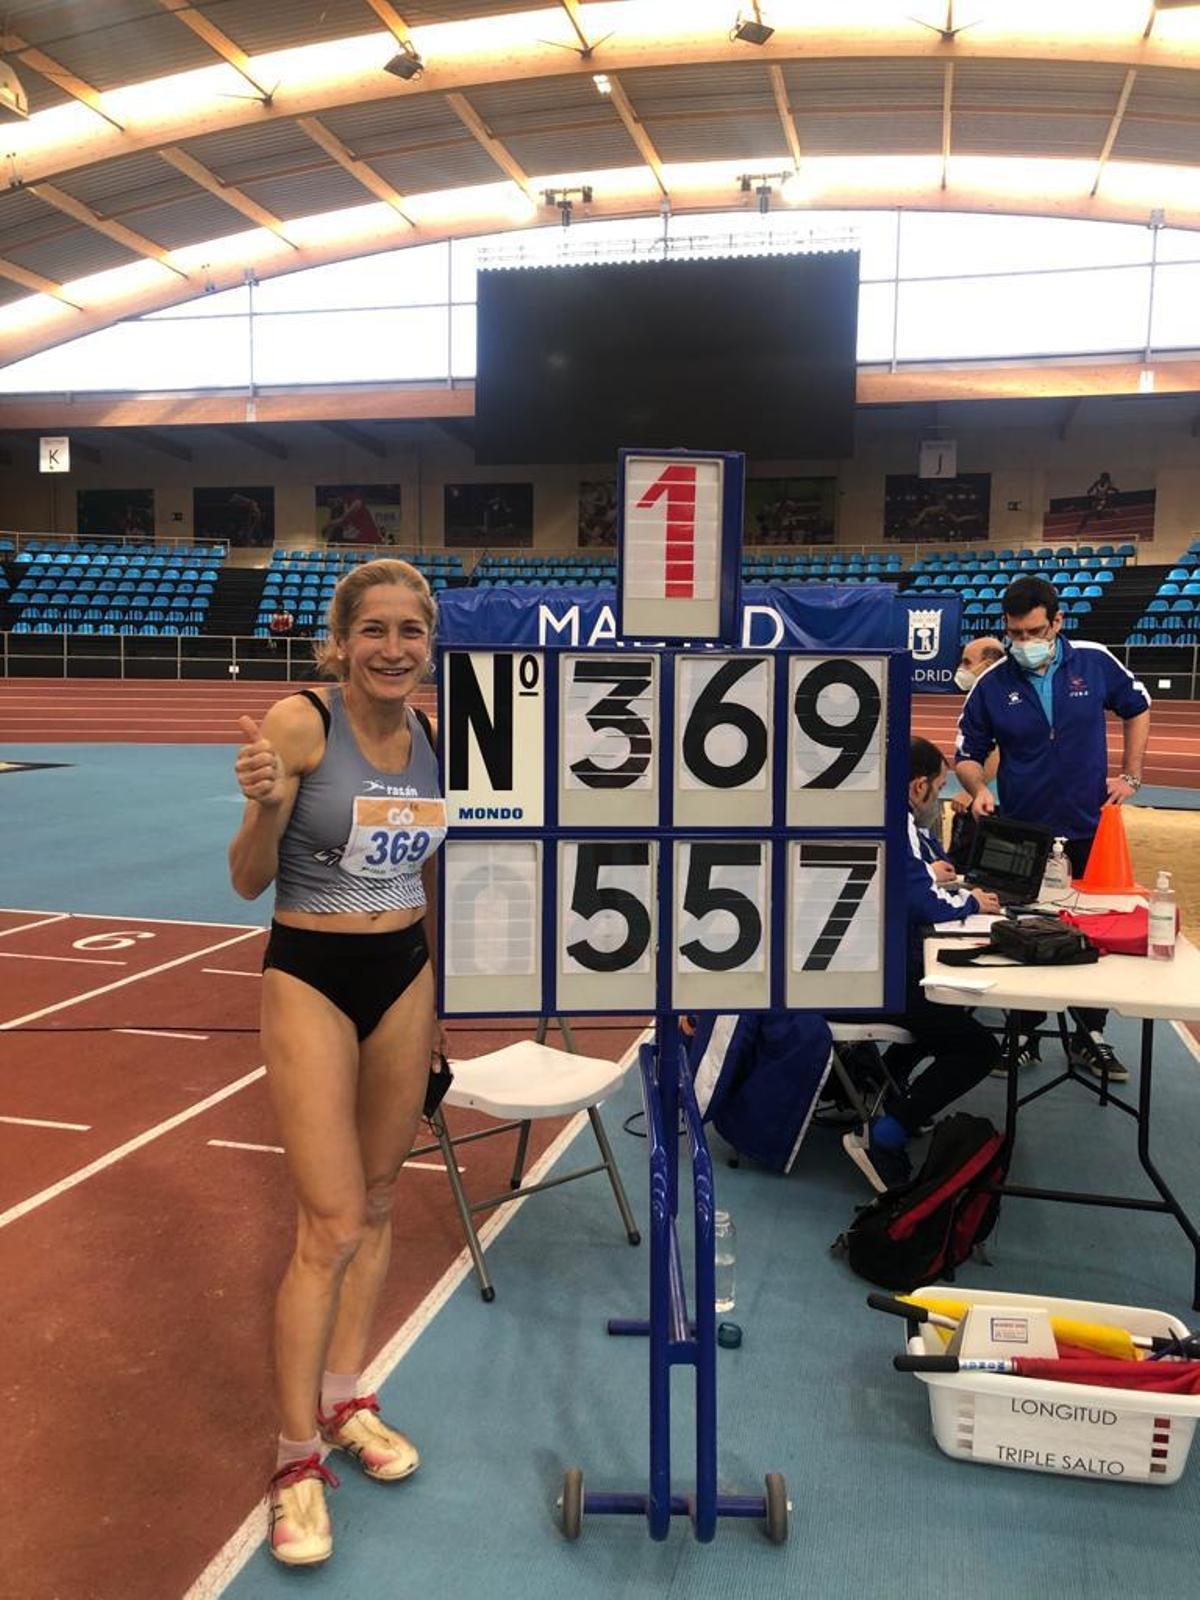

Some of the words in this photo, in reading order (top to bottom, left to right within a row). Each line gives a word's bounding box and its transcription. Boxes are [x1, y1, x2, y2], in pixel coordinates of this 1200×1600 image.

[49, 449, 60, 464] K
[636, 465, 696, 598] 1
[538, 605, 785, 649] MAD
[911, 669, 952, 682] DRID
[458, 807, 523, 820] MONDO
[365, 830, 431, 866] 369
[72, 931, 156, 951] 6
[1011, 1397, 1118, 1426] LONGITUD
[996, 1445, 1056, 1468] TRIPLE
[1062, 1455, 1125, 1476] SALTO
